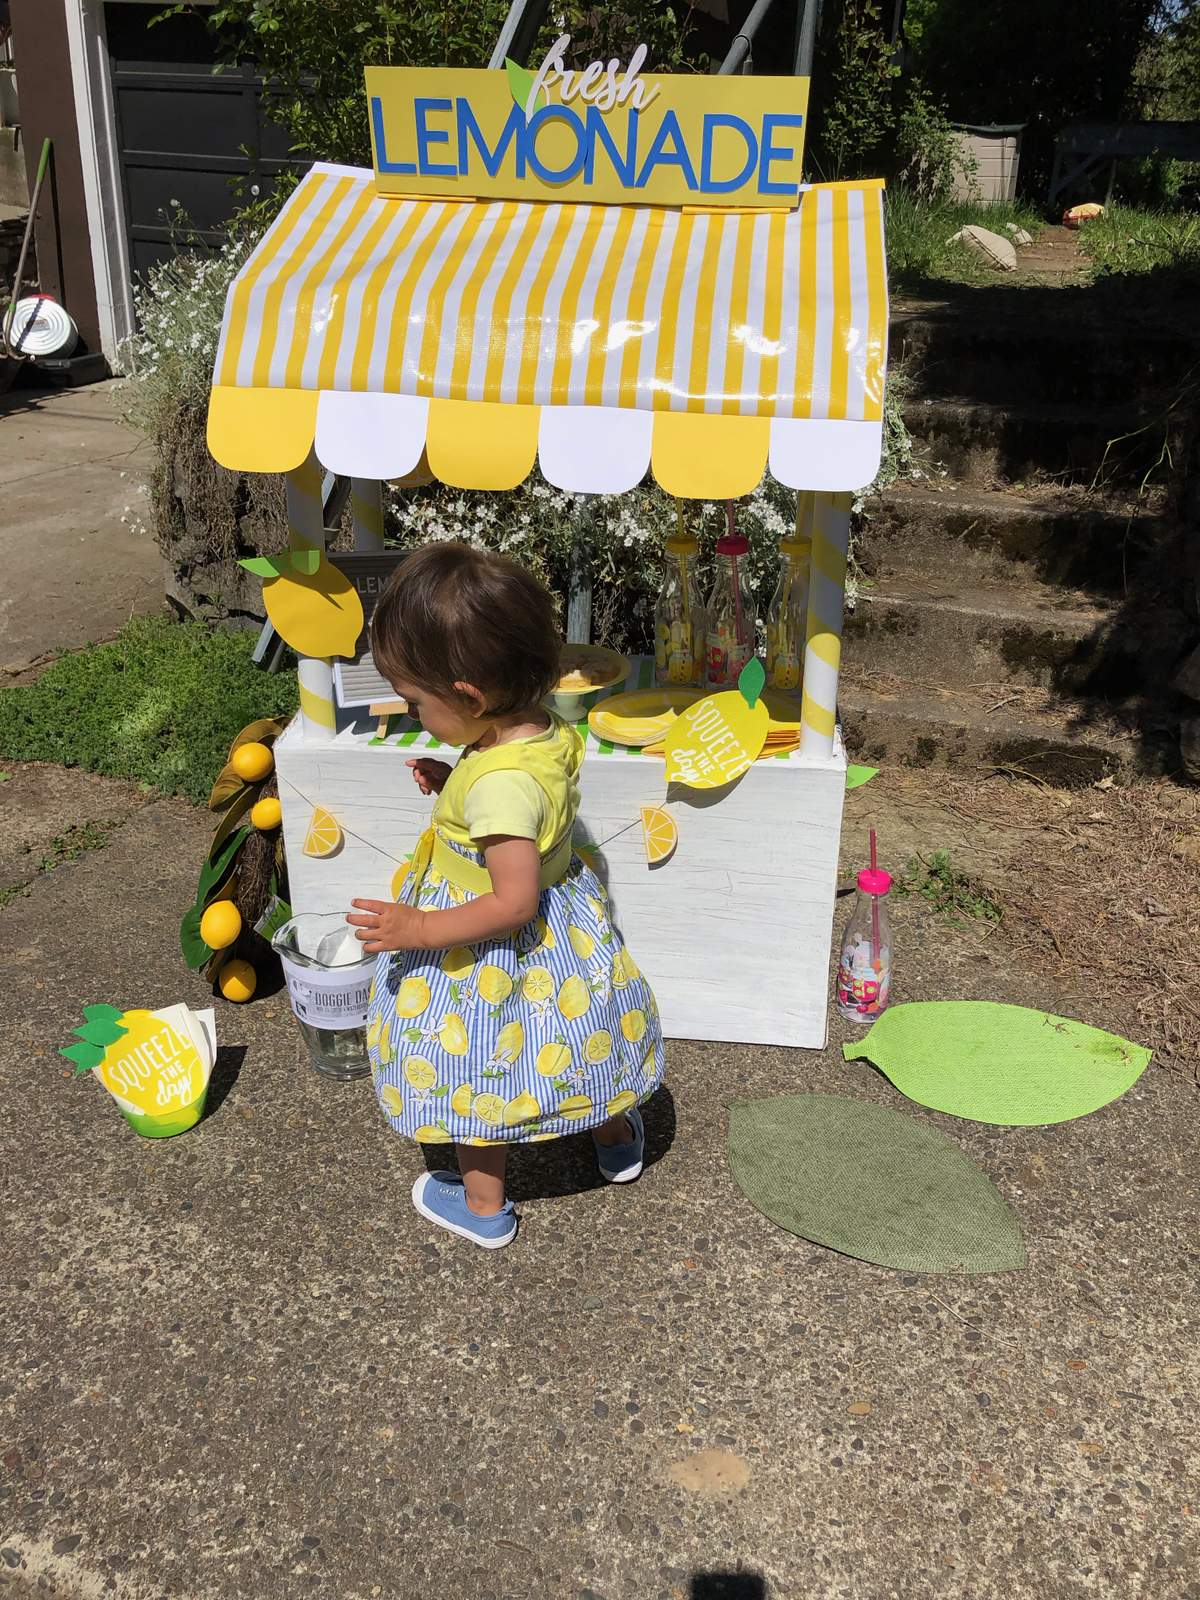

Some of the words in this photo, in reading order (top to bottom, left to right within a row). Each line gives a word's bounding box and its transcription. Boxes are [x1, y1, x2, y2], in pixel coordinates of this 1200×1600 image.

[526, 33, 661, 124] fresh
[371, 97, 803, 195] LEMONADE
[685, 700, 753, 781] SQUEEZE
[671, 748, 716, 787] day
[694, 751, 716, 775] THE
[315, 991, 352, 1007] DOGGIE
[355, 986, 371, 1004] DA
[156, 1056, 200, 1106] day
[160, 1061, 185, 1082] THE
